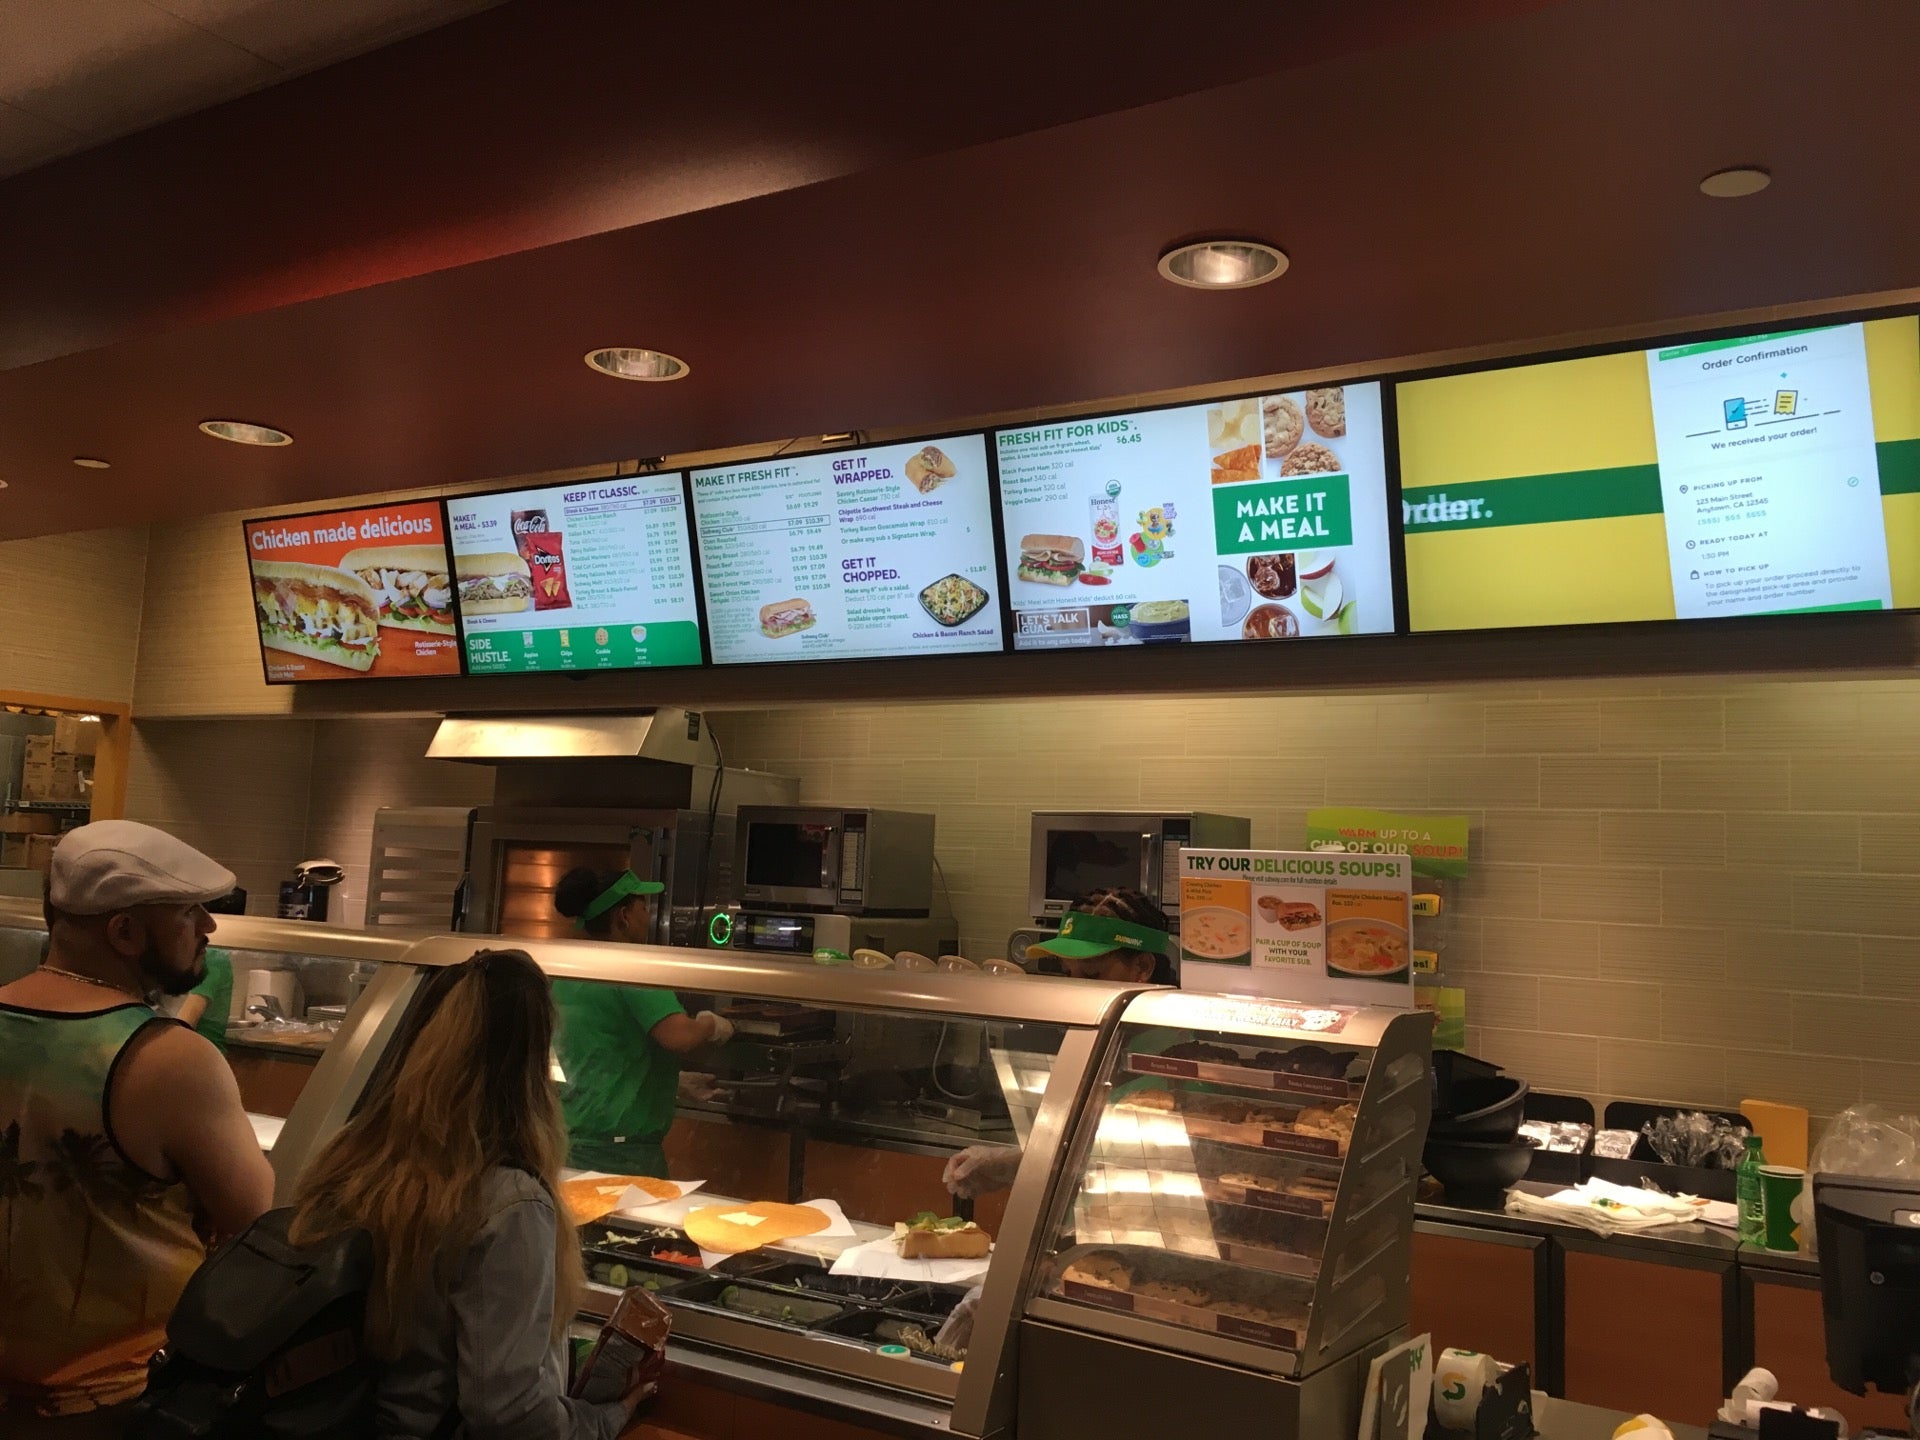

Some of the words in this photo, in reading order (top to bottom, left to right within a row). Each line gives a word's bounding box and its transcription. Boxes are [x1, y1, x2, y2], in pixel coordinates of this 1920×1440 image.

[1702, 353, 1733, 371] Order
[1736, 343, 1808, 362] Confirmation
[999, 432, 1040, 447] FRESH
[1045, 428, 1063, 440] FIT
[1067, 425, 1093, 438] FOR
[1117, 434, 1142, 444] $6.45
[1711, 442, 1726, 450] We
[1728, 435, 1765, 448] received
[1768, 432, 1787, 443] your
[1791, 426, 1817, 438] order!
[832, 459, 854, 471] GET
[857, 458, 867, 468] IT
[696, 476, 724, 488] MAKE
[727, 474, 735, 484] IT
[739, 470, 772, 482] FRESH
[834, 468, 893, 484] WRAPPED.
[1694, 482, 1725, 490] PICKING
[563, 491, 587, 503] KEEP
[588, 490, 596, 500] IT
[599, 486, 640, 499] CLASSIC.
[1730, 492, 1753, 500] Street
[838, 508, 861, 516] Chipotle
[862, 504, 891, 513] Southwest
[1236, 495, 1298, 518] MAKE
[1306, 492, 1327, 512] IT
[453, 514, 470, 523] MAKE
[461, 522, 476, 530] MEAL
[1238, 523, 1254, 543] A
[1260, 516, 1329, 540] MEAL
[252, 528, 311, 550] Chicken
[313, 522, 356, 544] made
[360, 515, 433, 539] delicious
[892, 532, 918, 540] Signature
[1729, 533, 1755, 541] TODAY
[534, 555, 560, 564] Doritos
[842, 558, 864, 570] GET
[866, 557, 876, 567] IT
[843, 568, 900, 582] CHOPPED.
[1716, 580, 1731, 588] pick
[1746, 578, 1761, 586] your
[1763, 592, 1784, 600] order
[1021, 614, 1050, 625] LET'S
[1052, 613, 1079, 623] TALK
[912, 631, 934, 639] Chicken
[1022, 624, 1054, 634] GUAC.
[470, 639, 491, 650] SIDE
[471, 651, 511, 663] HUSTLE.
[1338, 828, 1376, 838] WARM
[1380, 830, 1397, 839] UP
[1402, 830, 1418, 840] TO
[1423, 832, 1431, 840] A
[1347, 841, 1369, 853] OF
[1373, 843, 1408, 854] OUR
[1413, 845, 1463, 858] SOUP!
[1187, 856, 1214, 871] TRY
[1218, 857, 1250, 872] OUR
[1254, 858, 1334, 876] DELICIOUS
[1340, 861, 1401, 877] SOUPS!
